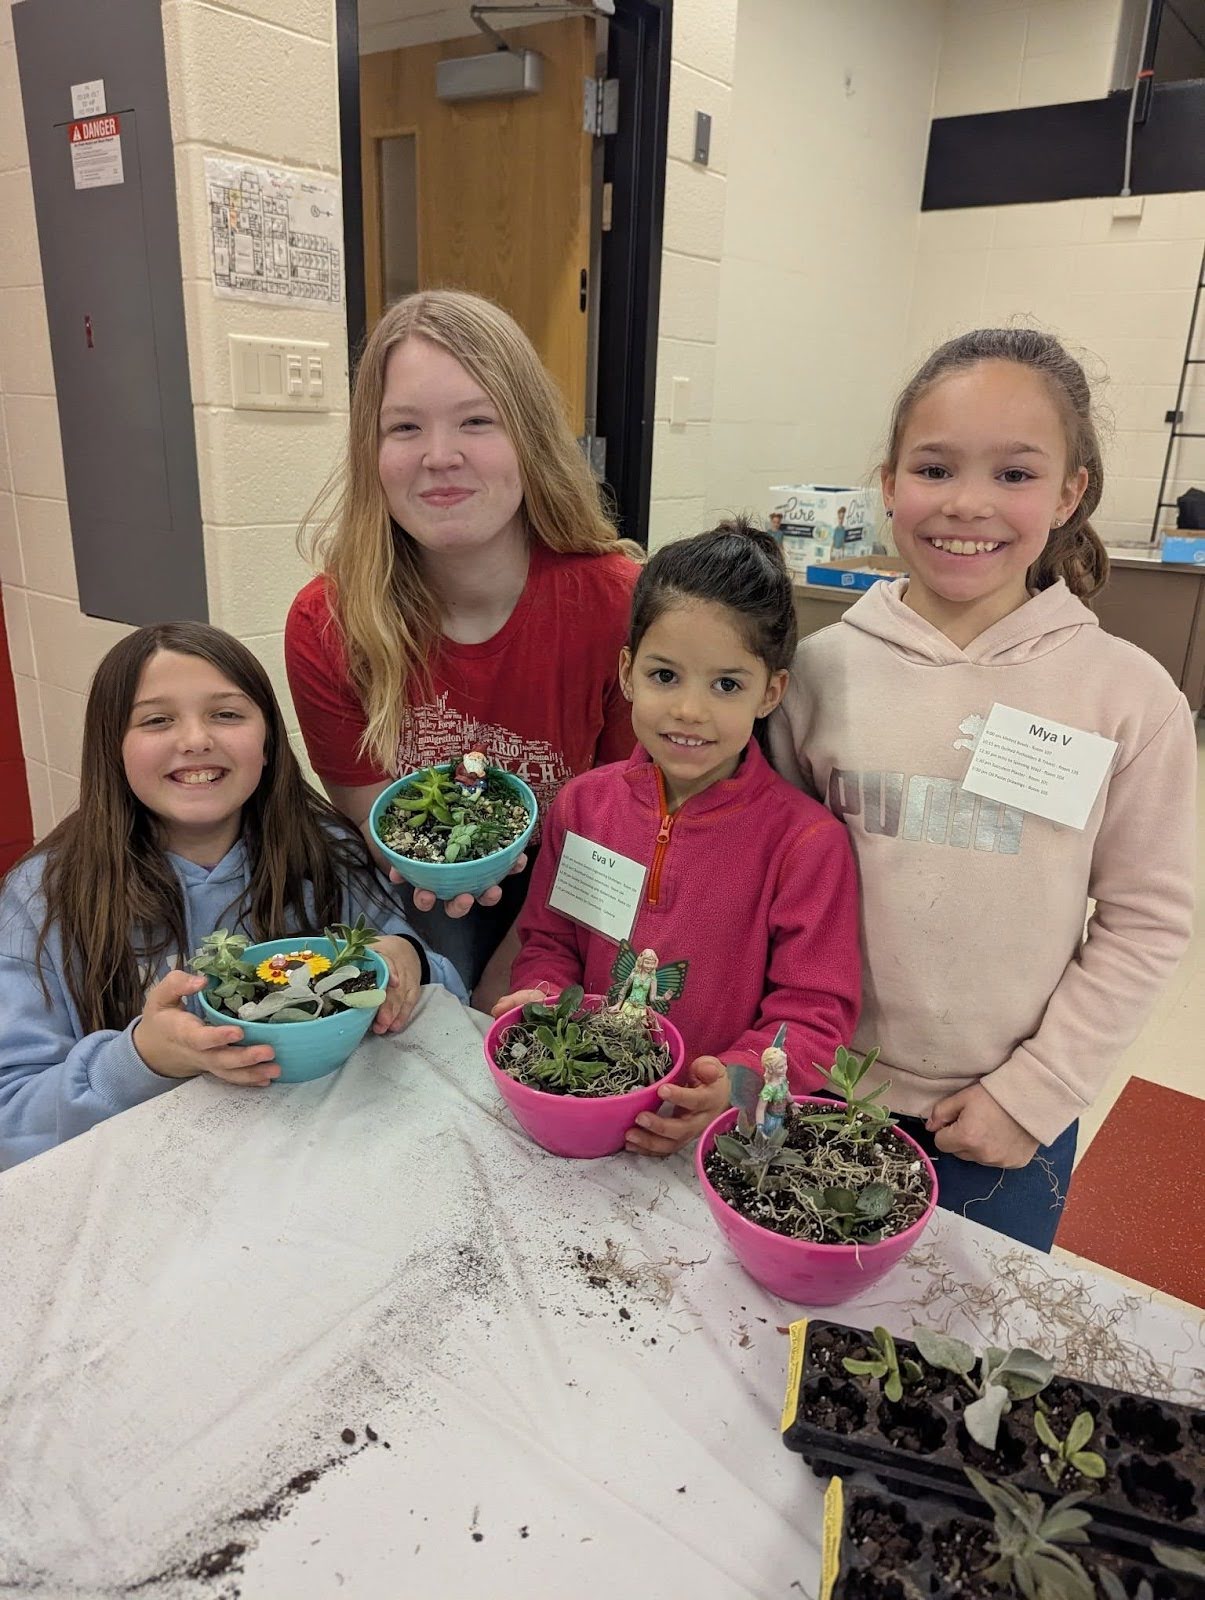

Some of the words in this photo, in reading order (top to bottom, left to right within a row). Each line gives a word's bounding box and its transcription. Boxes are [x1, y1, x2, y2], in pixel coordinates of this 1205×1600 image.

[82, 118, 117, 140] DANGER
[775, 496, 815, 522] Pure
[1028, 724, 1058, 744] Mya
[1061, 734, 1073, 747] V
[488, 740, 519, 757] ARIO
[516, 762, 557, 783] 4-H
[591, 850, 607, 866] Eva
[609, 857, 616, 869] V
